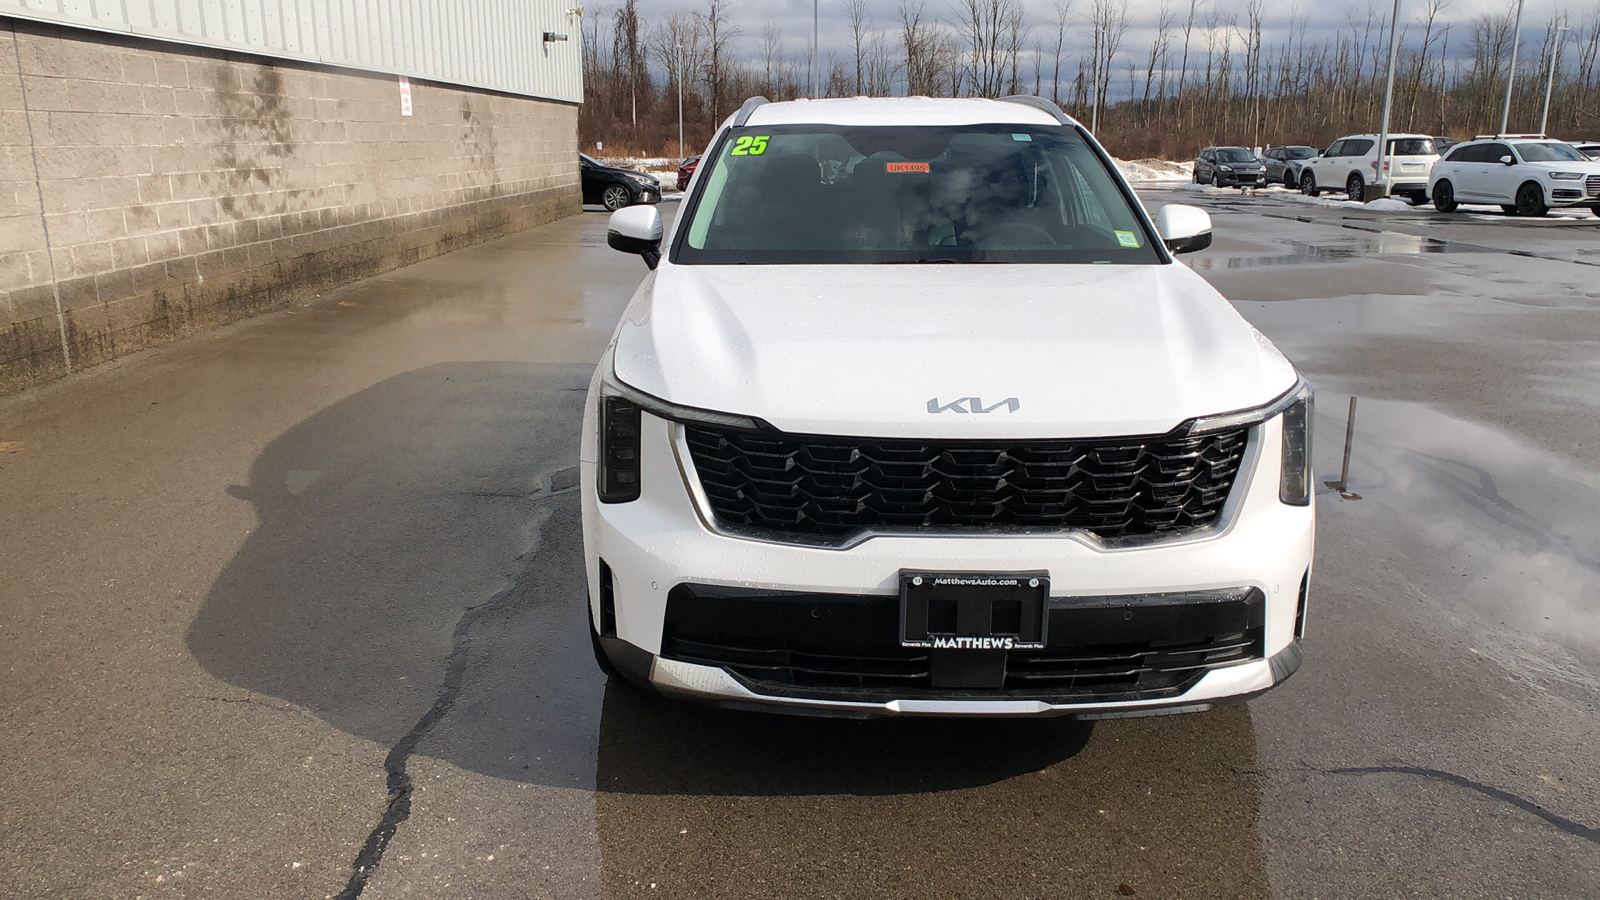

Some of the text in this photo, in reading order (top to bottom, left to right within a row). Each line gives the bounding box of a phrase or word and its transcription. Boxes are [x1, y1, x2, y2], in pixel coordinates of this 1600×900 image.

[731, 136, 769, 155] 25
[927, 397, 1020, 413] KIA
[934, 577, 1018, 586] MatthewsAuto.com
[934, 637, 1013, 649] MATTHEWS
